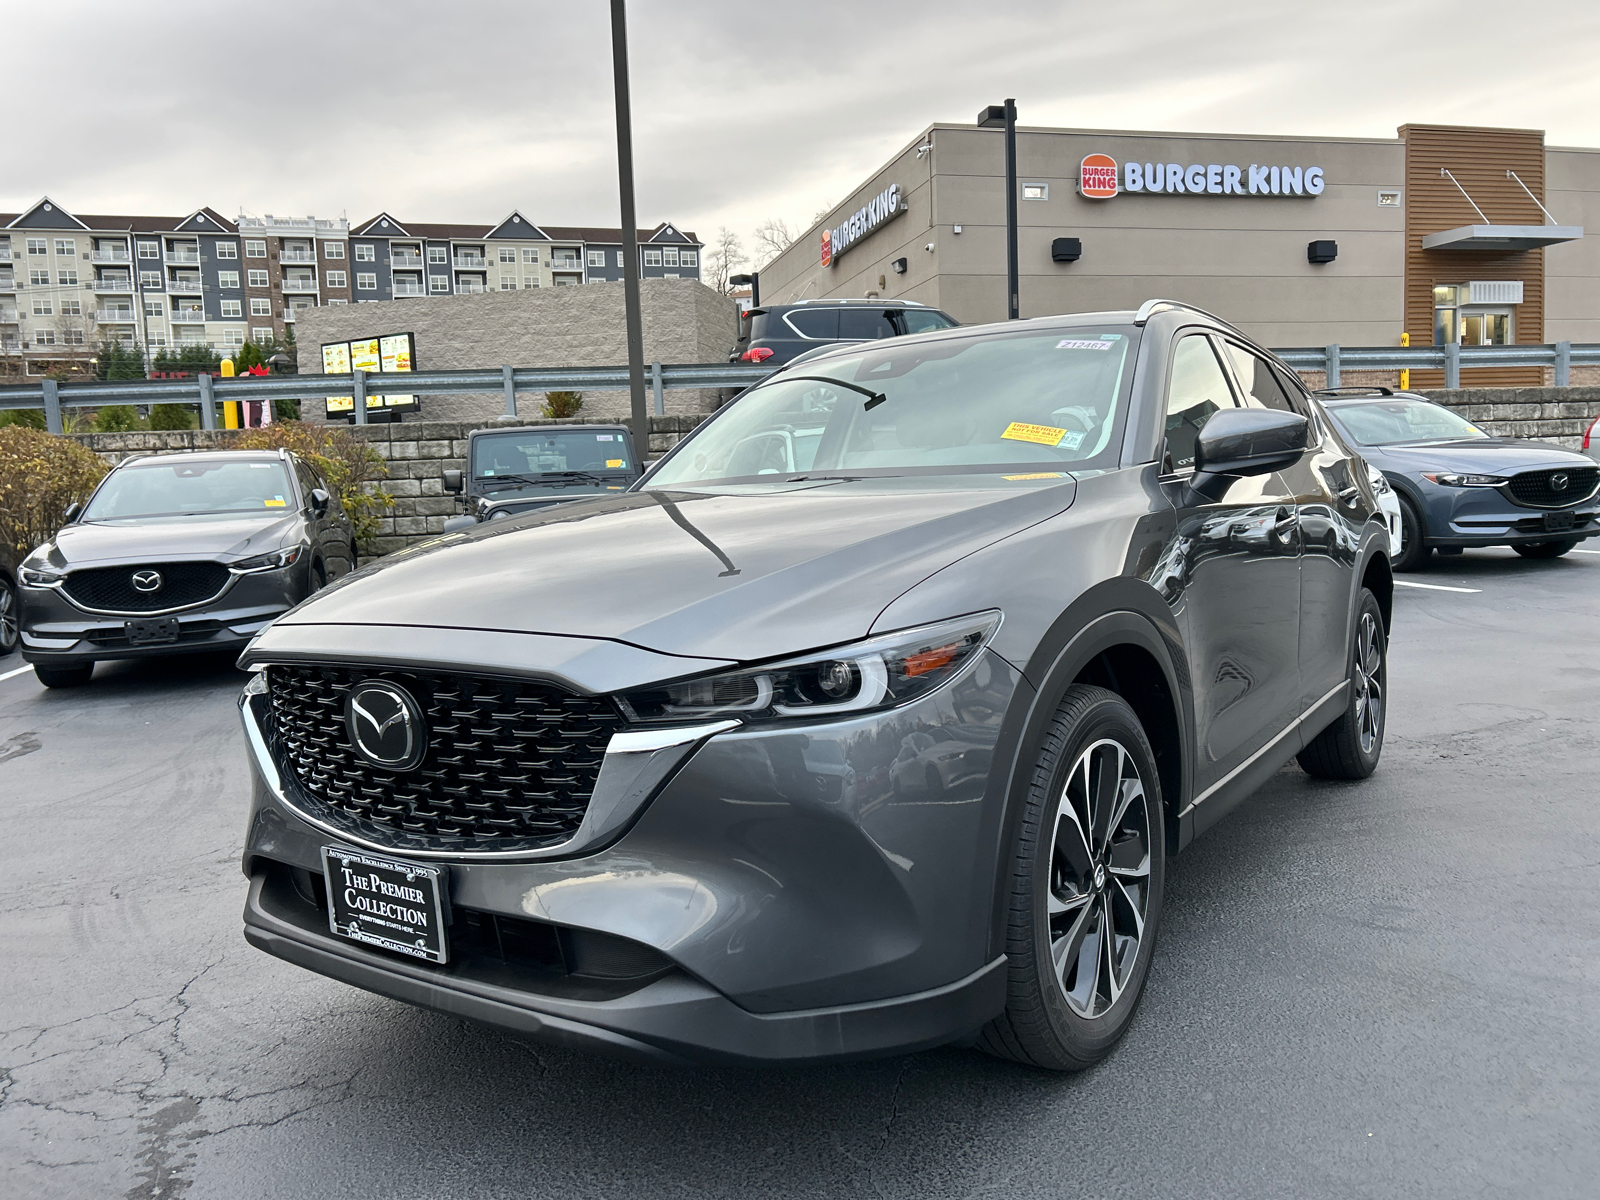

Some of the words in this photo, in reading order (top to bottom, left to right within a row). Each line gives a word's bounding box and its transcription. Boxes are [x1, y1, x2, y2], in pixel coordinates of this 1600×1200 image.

[1082, 167, 1116, 177] BURGER
[1082, 176, 1116, 189] KING
[1124, 162, 1243, 194] BURGER
[1248, 164, 1325, 196] KING
[831, 206, 868, 255] BURGER
[867, 183, 898, 229] KING
[1031, 425, 1064, 434] VEHICLE
[341, 867, 369, 891] THE
[369, 873, 426, 904] PREMIER
[344, 888, 428, 927] COLLECTION
[359, 914, 386, 926] EVERYTHING
[386, 921, 401, 930] STARTS
